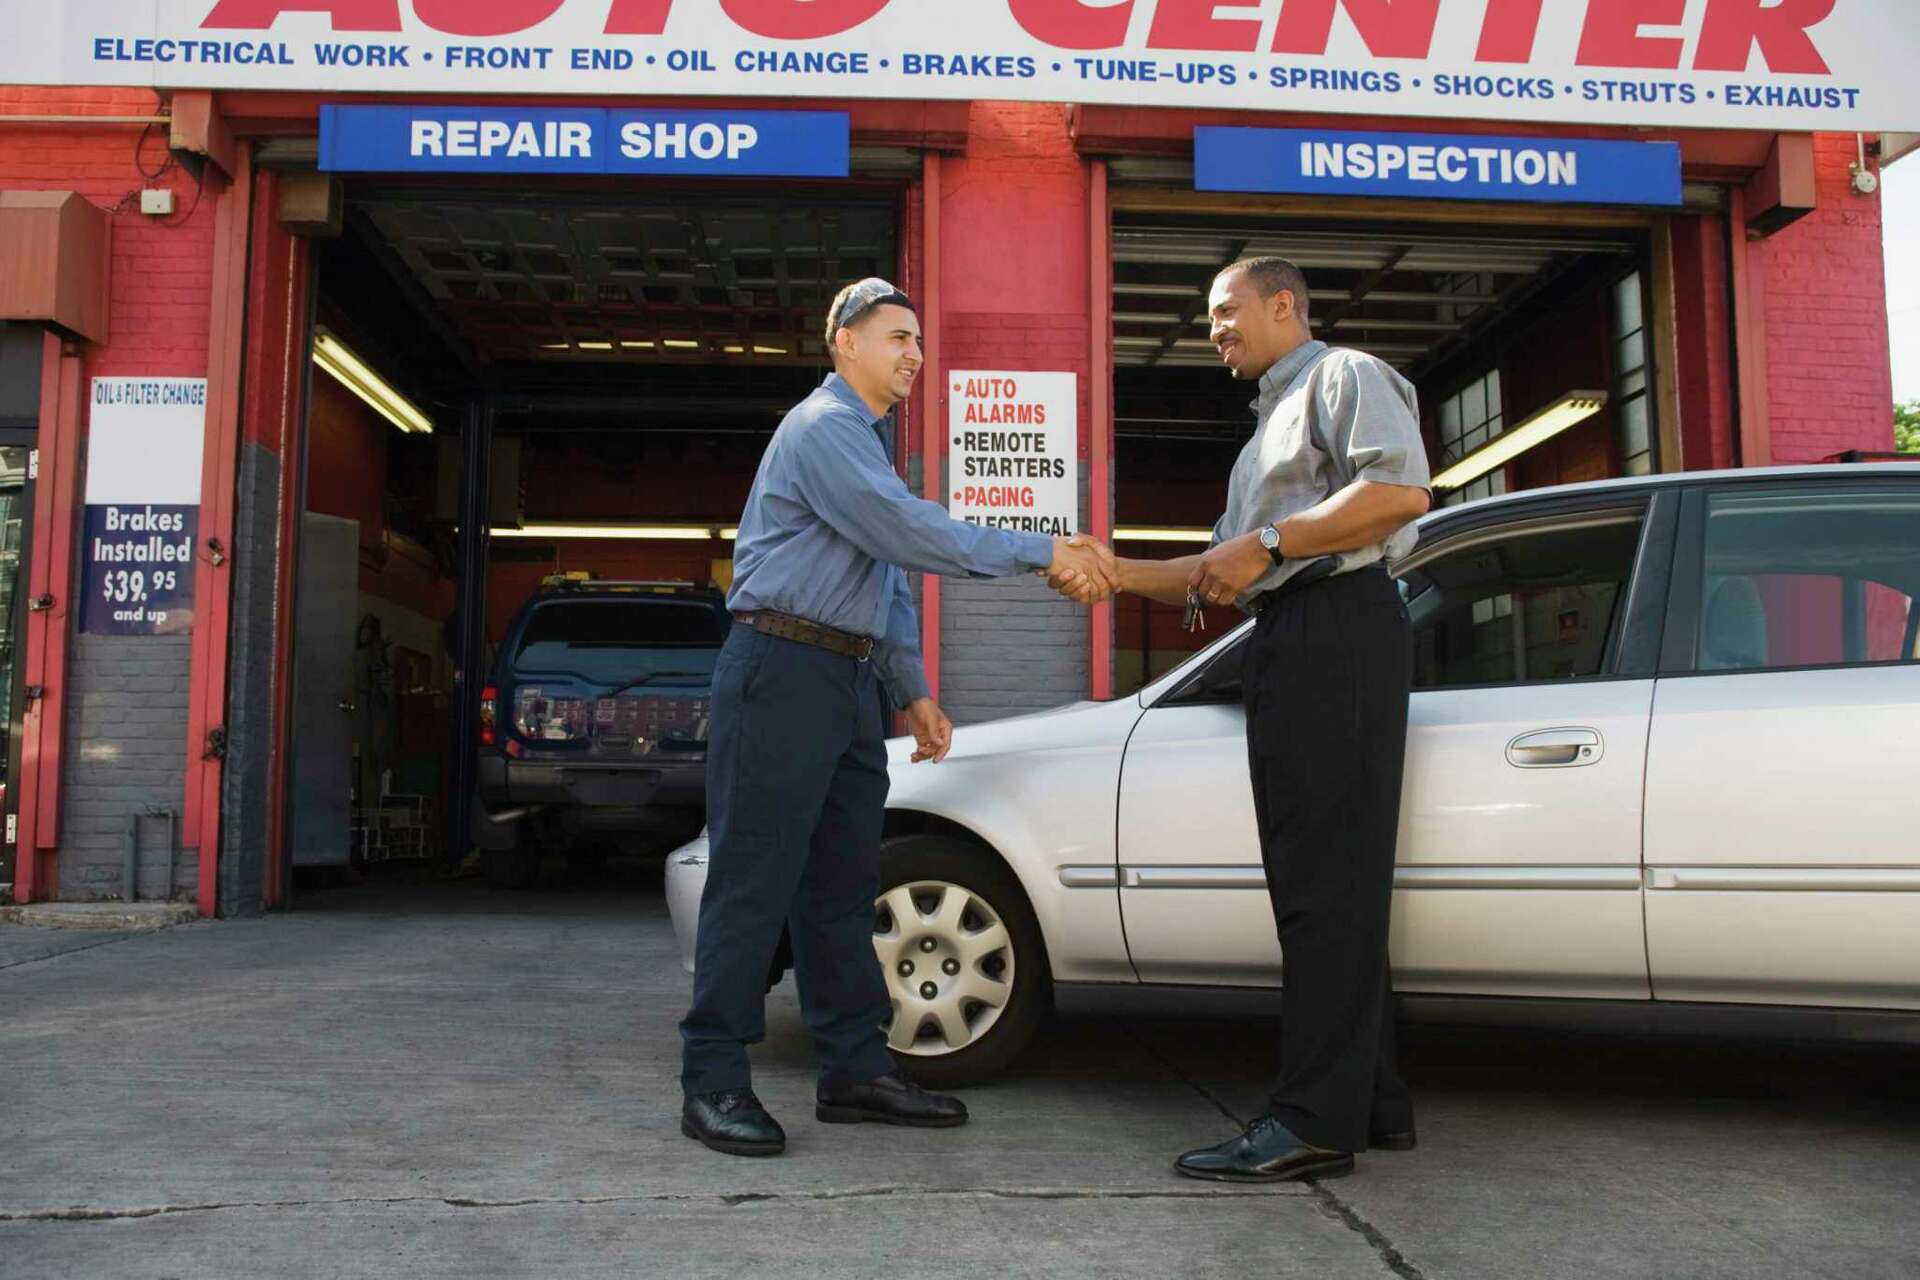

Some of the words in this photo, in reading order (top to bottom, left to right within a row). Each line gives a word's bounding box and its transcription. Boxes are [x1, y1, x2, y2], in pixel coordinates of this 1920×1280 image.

[92, 37, 294, 65] ELECTRICAL
[314, 43, 409, 68] WORK
[445, 45, 553, 71] FRONT
[570, 48, 634, 71] END
[666, 49, 716, 72] OIL
[735, 48, 869, 75] CHANGE
[901, 52, 1037, 78] BRAKES
[1074, 57, 1237, 86] TUNE-UPS
[1270, 66, 1402, 93] SPRINGS
[1433, 74, 1555, 99] SHOCKS
[1582, 79, 1697, 103] STRUTS
[1725, 84, 1860, 109] EXHAUST
[410, 120, 592, 158] REPAIR
[620, 122, 759, 160] SHOP
[1301, 142, 1577, 186] INSPECTION
[96, 384, 114, 404] OIL
[125, 384, 160, 404] FILTER
[162, 384, 205, 405] CHANGE
[965, 378, 1017, 398] AUTO
[965, 403, 1046, 424] ALARMS
[964, 431, 1046, 452] REMOTE
[964, 456, 1065, 478] STARTERS
[964, 486, 1034, 507] PAGING
[105, 506, 183, 531] Brakes
[965, 515, 1071, 536] ECTRICAL
[94, 537, 191, 562] Installed
[113, 607, 144, 621] and
[147, 610, 167, 625] up
